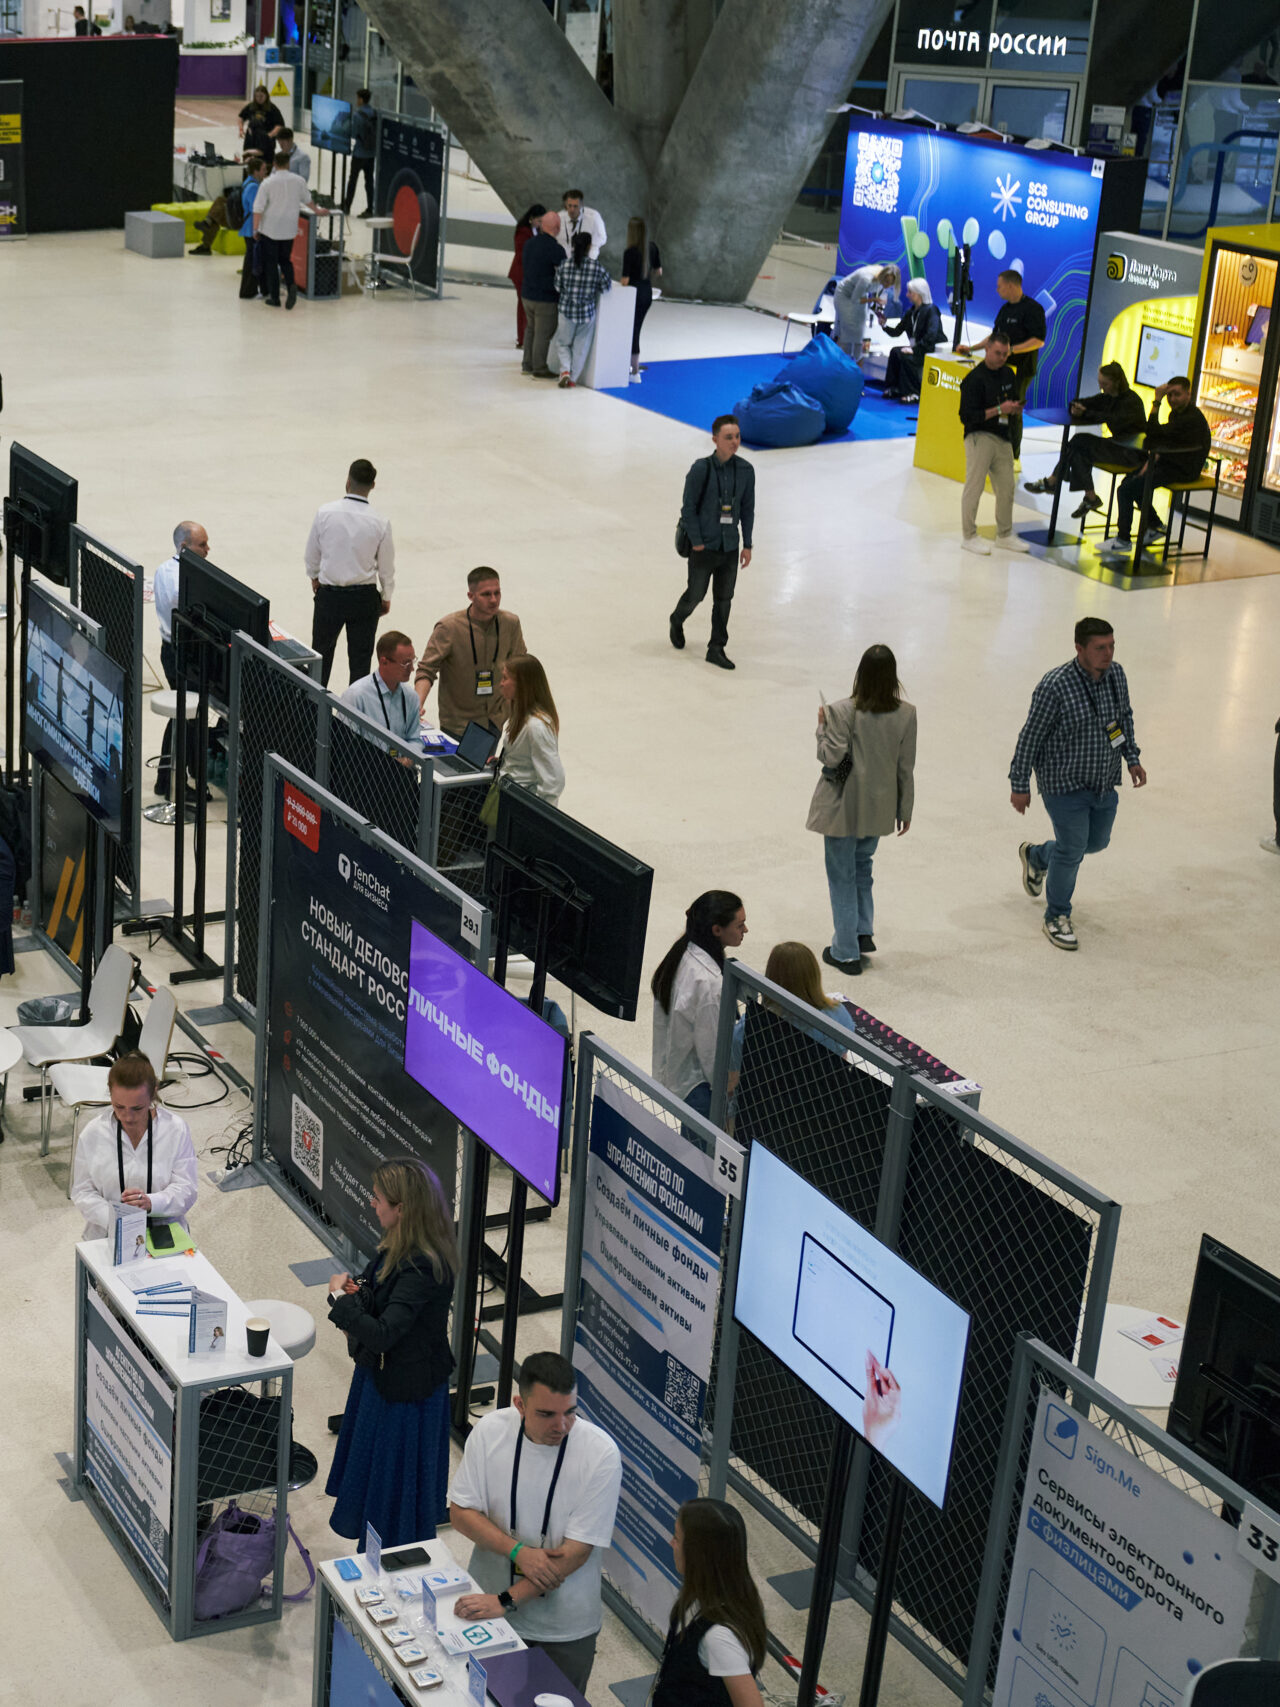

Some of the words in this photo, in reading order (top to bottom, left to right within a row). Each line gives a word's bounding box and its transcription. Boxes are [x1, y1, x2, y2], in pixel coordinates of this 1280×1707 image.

[917, 28, 980, 52] ПОЧТА
[989, 32, 1068, 56] РОССИИ
[1026, 195, 1089, 221] CONSULTING
[1028, 181, 1048, 198] SCS
[1025, 211, 1060, 229] GROUP
[1129, 258, 1153, 277] Ланч
[27, 703, 94, 778] МНОГОМИЛЛИОННЫЕ
[72, 765, 100, 804] СДЕЛКИ
[352, 860, 391, 902] TenChat
[353, 880, 364, 895] ДЛЯ
[364, 887, 389, 913] БИЗНЕСА
[310, 894, 354, 949] НОВЫЙ
[354, 935, 409, 993] ДЕЛОВО
[463, 914, 479, 936] 29.1
[301, 920, 366, 989] СТАНДАРТ
[368, 975, 406, 1022] РОСС
[408, 986, 484, 1067] ЛИЧНЫЕ
[486, 1051, 560, 1129] ФОНДЫ
[342, 1166, 360, 1188] будет
[606, 1140, 657, 1198] УПРАВЛЕНИЮ
[658, 1185, 704, 1234] ФОНДАМИ
[626, 1136, 671, 1187] АГЕНТСТВО
[672, 1174, 685, 1197] ПО
[718, 1155, 738, 1183] 35
[596, 1175, 631, 1220] Создаём
[632, 1213, 670, 1252] личные
[671, 1244, 709, 1283] фонды
[594, 1205, 629, 1248] Управляем
[629, 1242, 666, 1279] частными
[667, 1276, 706, 1313] активами
[600, 1240, 658, 1302] Оцифровываем
[659, 1299, 692, 1333] активы
[143, 1432, 164, 1467] фонды
[1084, 1444, 1142, 1499] Sign.Me
[1030, 1515, 1040, 1530] с
[1042, 1523, 1130, 1606] физлицами
[1033, 1493, 1184, 1623] документооборота
[1037, 1468, 1106, 1534] Сервисы
[1108, 1527, 1225, 1626] электронного
[1246, 1523, 1280, 1563] 33
